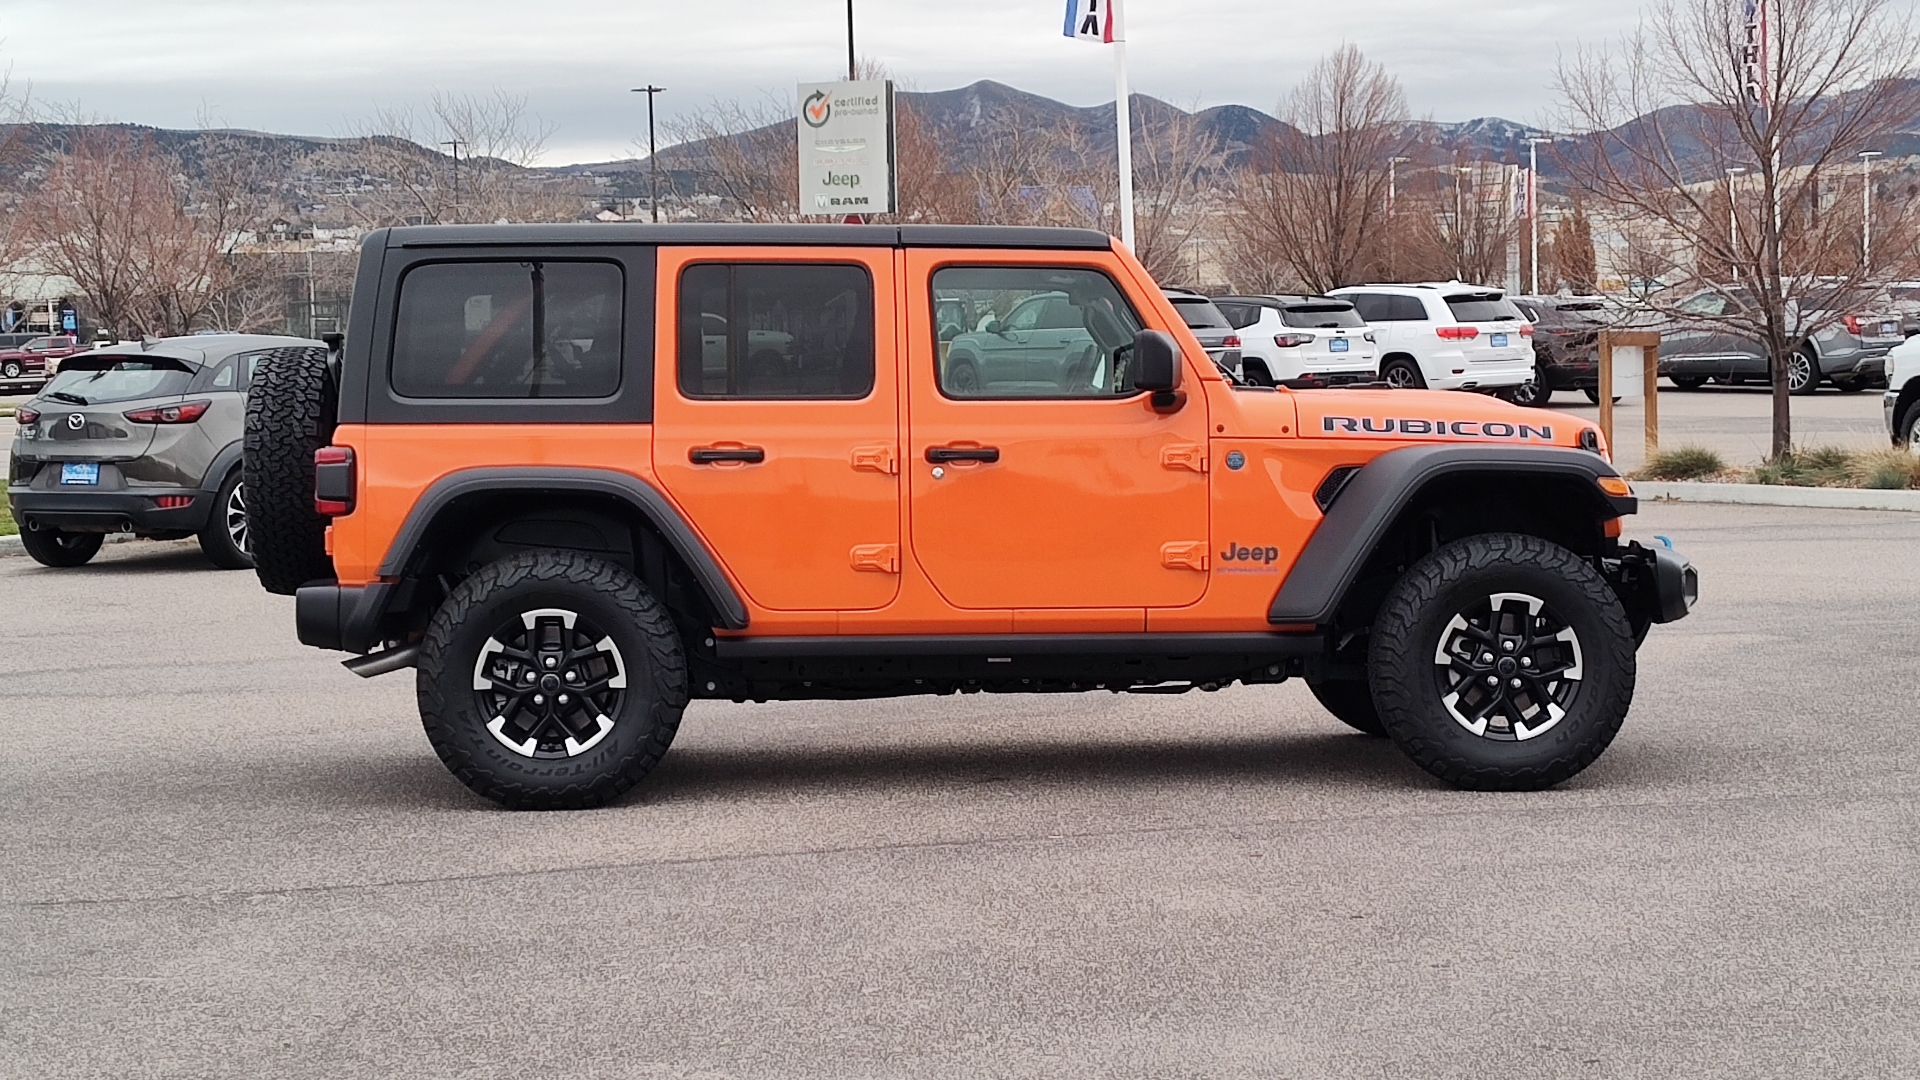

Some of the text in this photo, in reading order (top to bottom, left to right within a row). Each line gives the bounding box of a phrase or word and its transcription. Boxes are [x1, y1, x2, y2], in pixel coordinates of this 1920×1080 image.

[834, 95, 878, 107] certified
[834, 107, 879, 118] pre-owned
[822, 171, 860, 188] Jeep
[830, 196, 869, 206] RAM
[1323, 416, 1552, 440] RUBICON
[1220, 541, 1279, 565] Jeep
